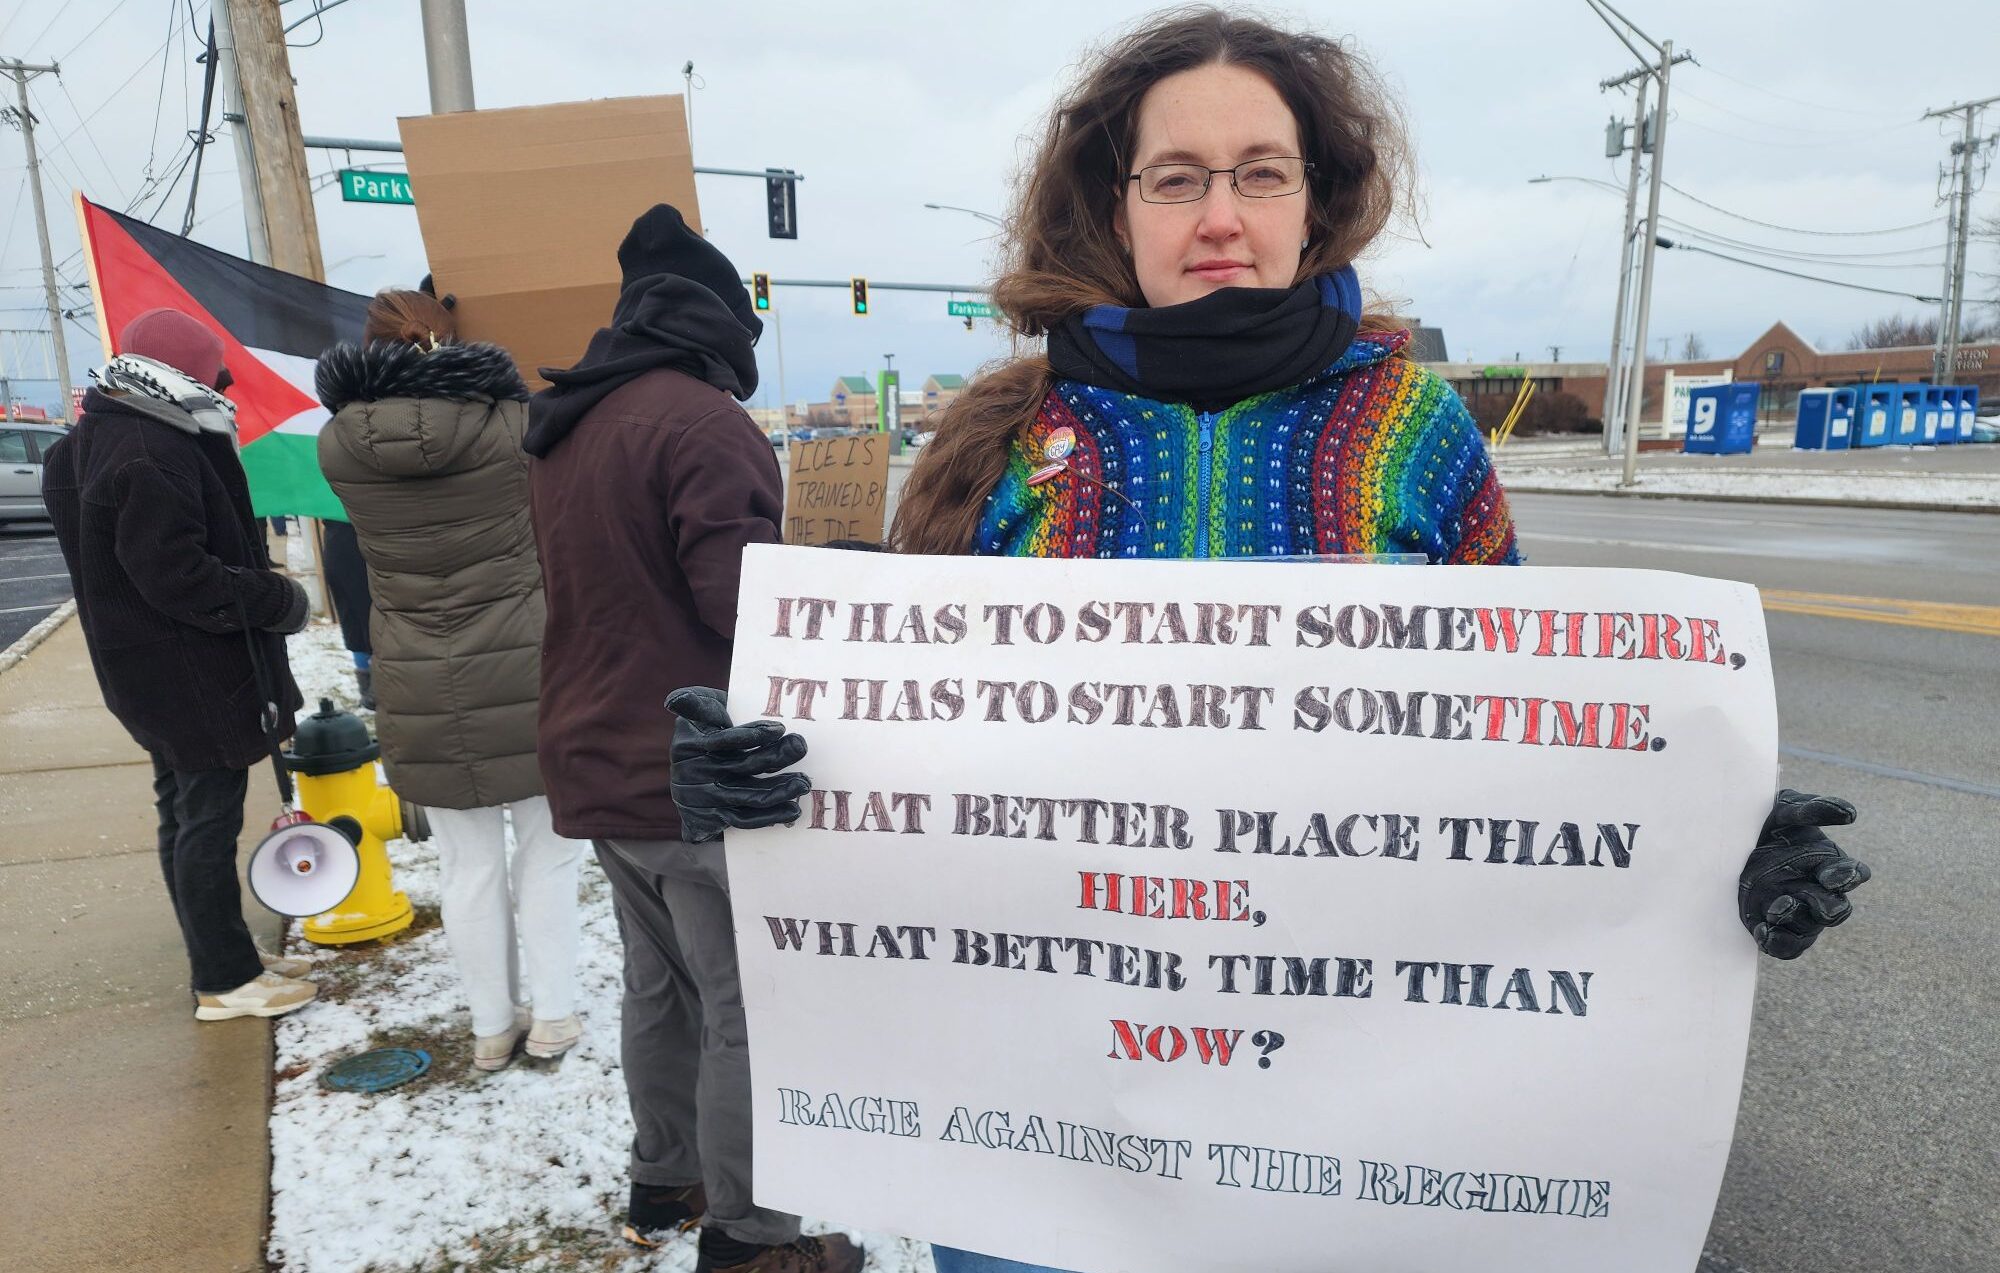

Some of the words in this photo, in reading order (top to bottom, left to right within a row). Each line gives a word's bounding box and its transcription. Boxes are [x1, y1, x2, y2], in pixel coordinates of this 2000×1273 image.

[795, 439, 836, 473] ICE
[843, 437, 875, 466] IS
[797, 481, 863, 511] TRAINED
[867, 481, 888, 515] BY
[788, 516, 815, 546] THE
[769, 597, 836, 641] IT
[843, 602, 968, 645] HAS
[983, 602, 1066, 646] TO
[1075, 600, 1282, 648] START
[1295, 604, 1747, 671] SOMEWHERE,
[761, 675, 828, 721] IT
[838, 677, 966, 722] HAS
[976, 679, 1060, 724] TO
[1067, 681, 1275, 731] START
[1293, 685, 1667, 753] SOMETIME.
[785, 789, 932, 835] HAT
[951, 792, 1194, 851] BETTER
[1213, 809, 1420, 863] PLACE
[1439, 817, 1642, 869] THAN
[1075, 871, 1268, 928] HERE,
[763, 915, 936, 961] WHAT
[951, 928, 1188, 993] BETTER
[1208, 954, 1374, 999] TIME
[1395, 959, 1595, 1018] THAN
[1106, 1019, 1286, 1070] NOW?
[777, 1087, 921, 1138] RAGE
[939, 1106, 1192, 1181] AGAINST
[1208, 1143, 1342, 1196] THE
[1355, 1159, 1611, 1219] REGIME
